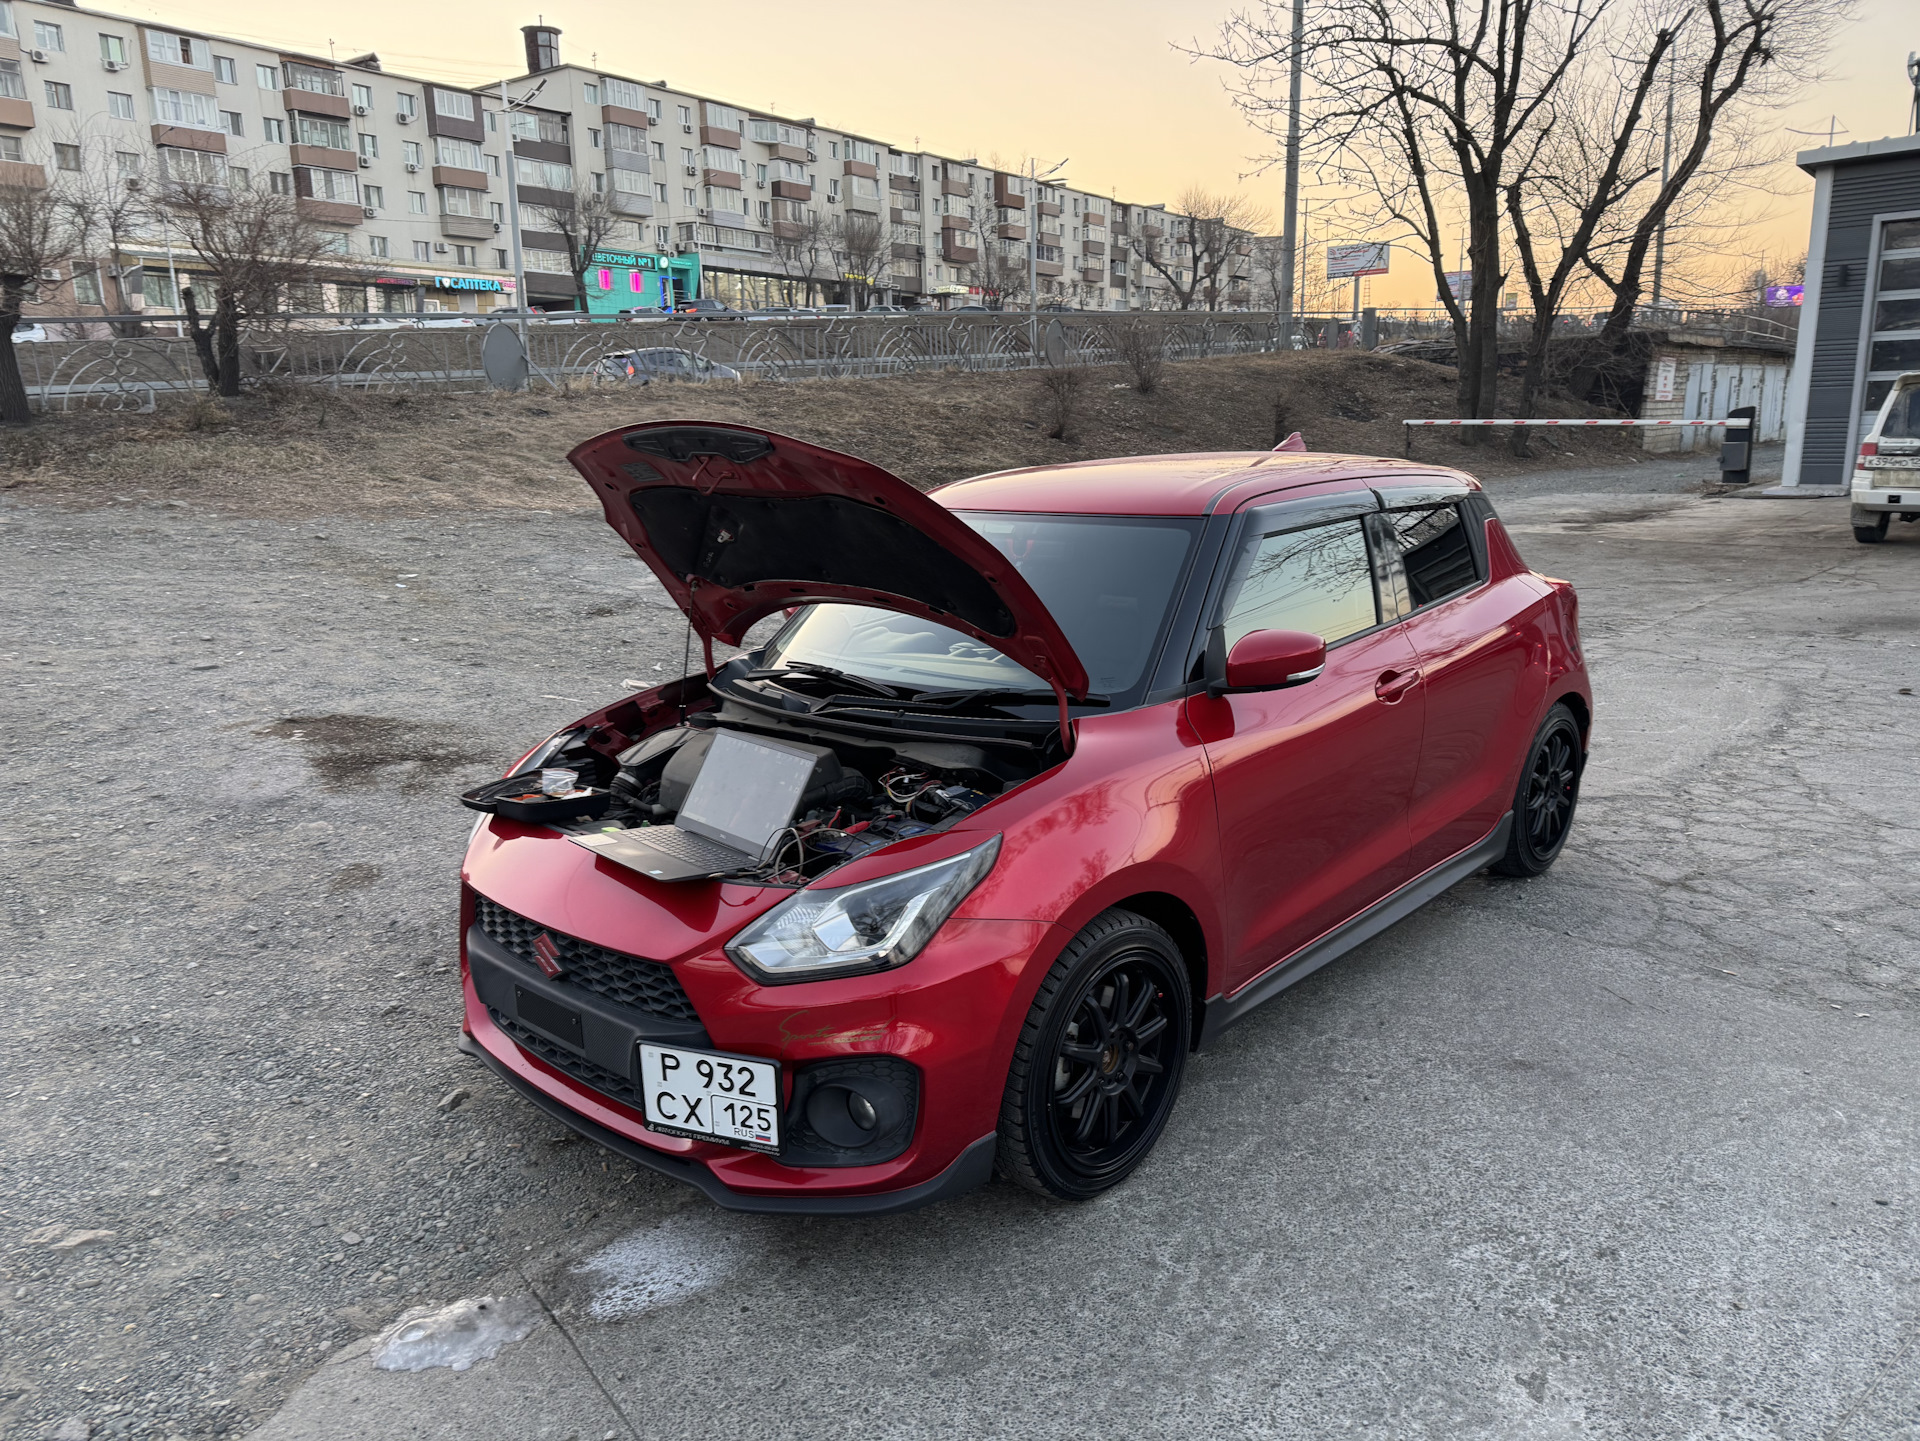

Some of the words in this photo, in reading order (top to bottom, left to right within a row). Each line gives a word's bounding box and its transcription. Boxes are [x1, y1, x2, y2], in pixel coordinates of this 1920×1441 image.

[592, 252, 636, 266] ЦВЕТОЧНЫЙ
[660, 1052, 681, 1082] Р
[696, 1059, 757, 1097] 932
[656, 1091, 705, 1127] СХ
[723, 1102, 771, 1132] 125
[733, 1127, 755, 1139] RUS
